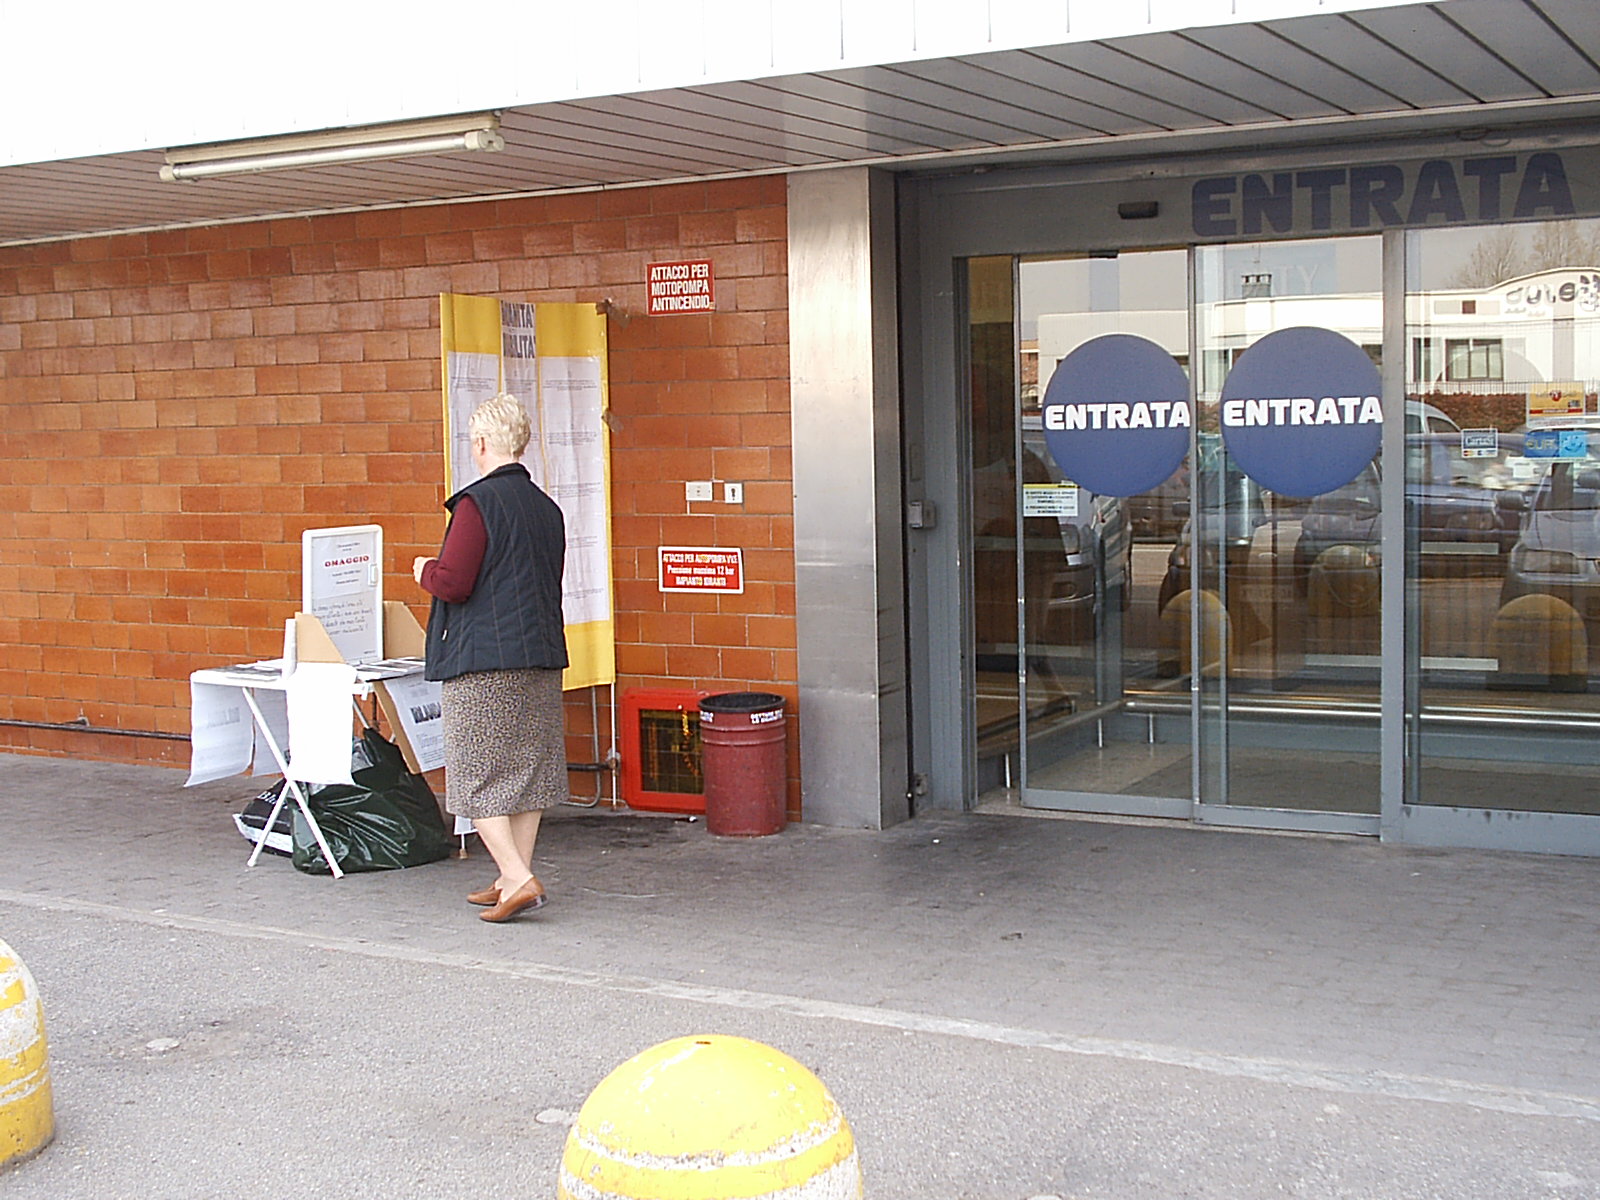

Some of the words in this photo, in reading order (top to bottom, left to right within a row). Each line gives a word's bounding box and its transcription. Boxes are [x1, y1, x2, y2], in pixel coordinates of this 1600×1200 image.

[1192, 152, 1574, 237] ENTRATA
[651, 265, 689, 281] ATTACCO
[691, 264, 709, 278] PER
[651, 279, 709, 296] MOTOPOMPA
[652, 295, 710, 312] ANTINCENDIO
[1045, 400, 1190, 430] ENTRATA
[1223, 396, 1383, 426] ENTRATA
[324, 555, 370, 567] OMAGGIO
[717, 566, 724, 575] 12
